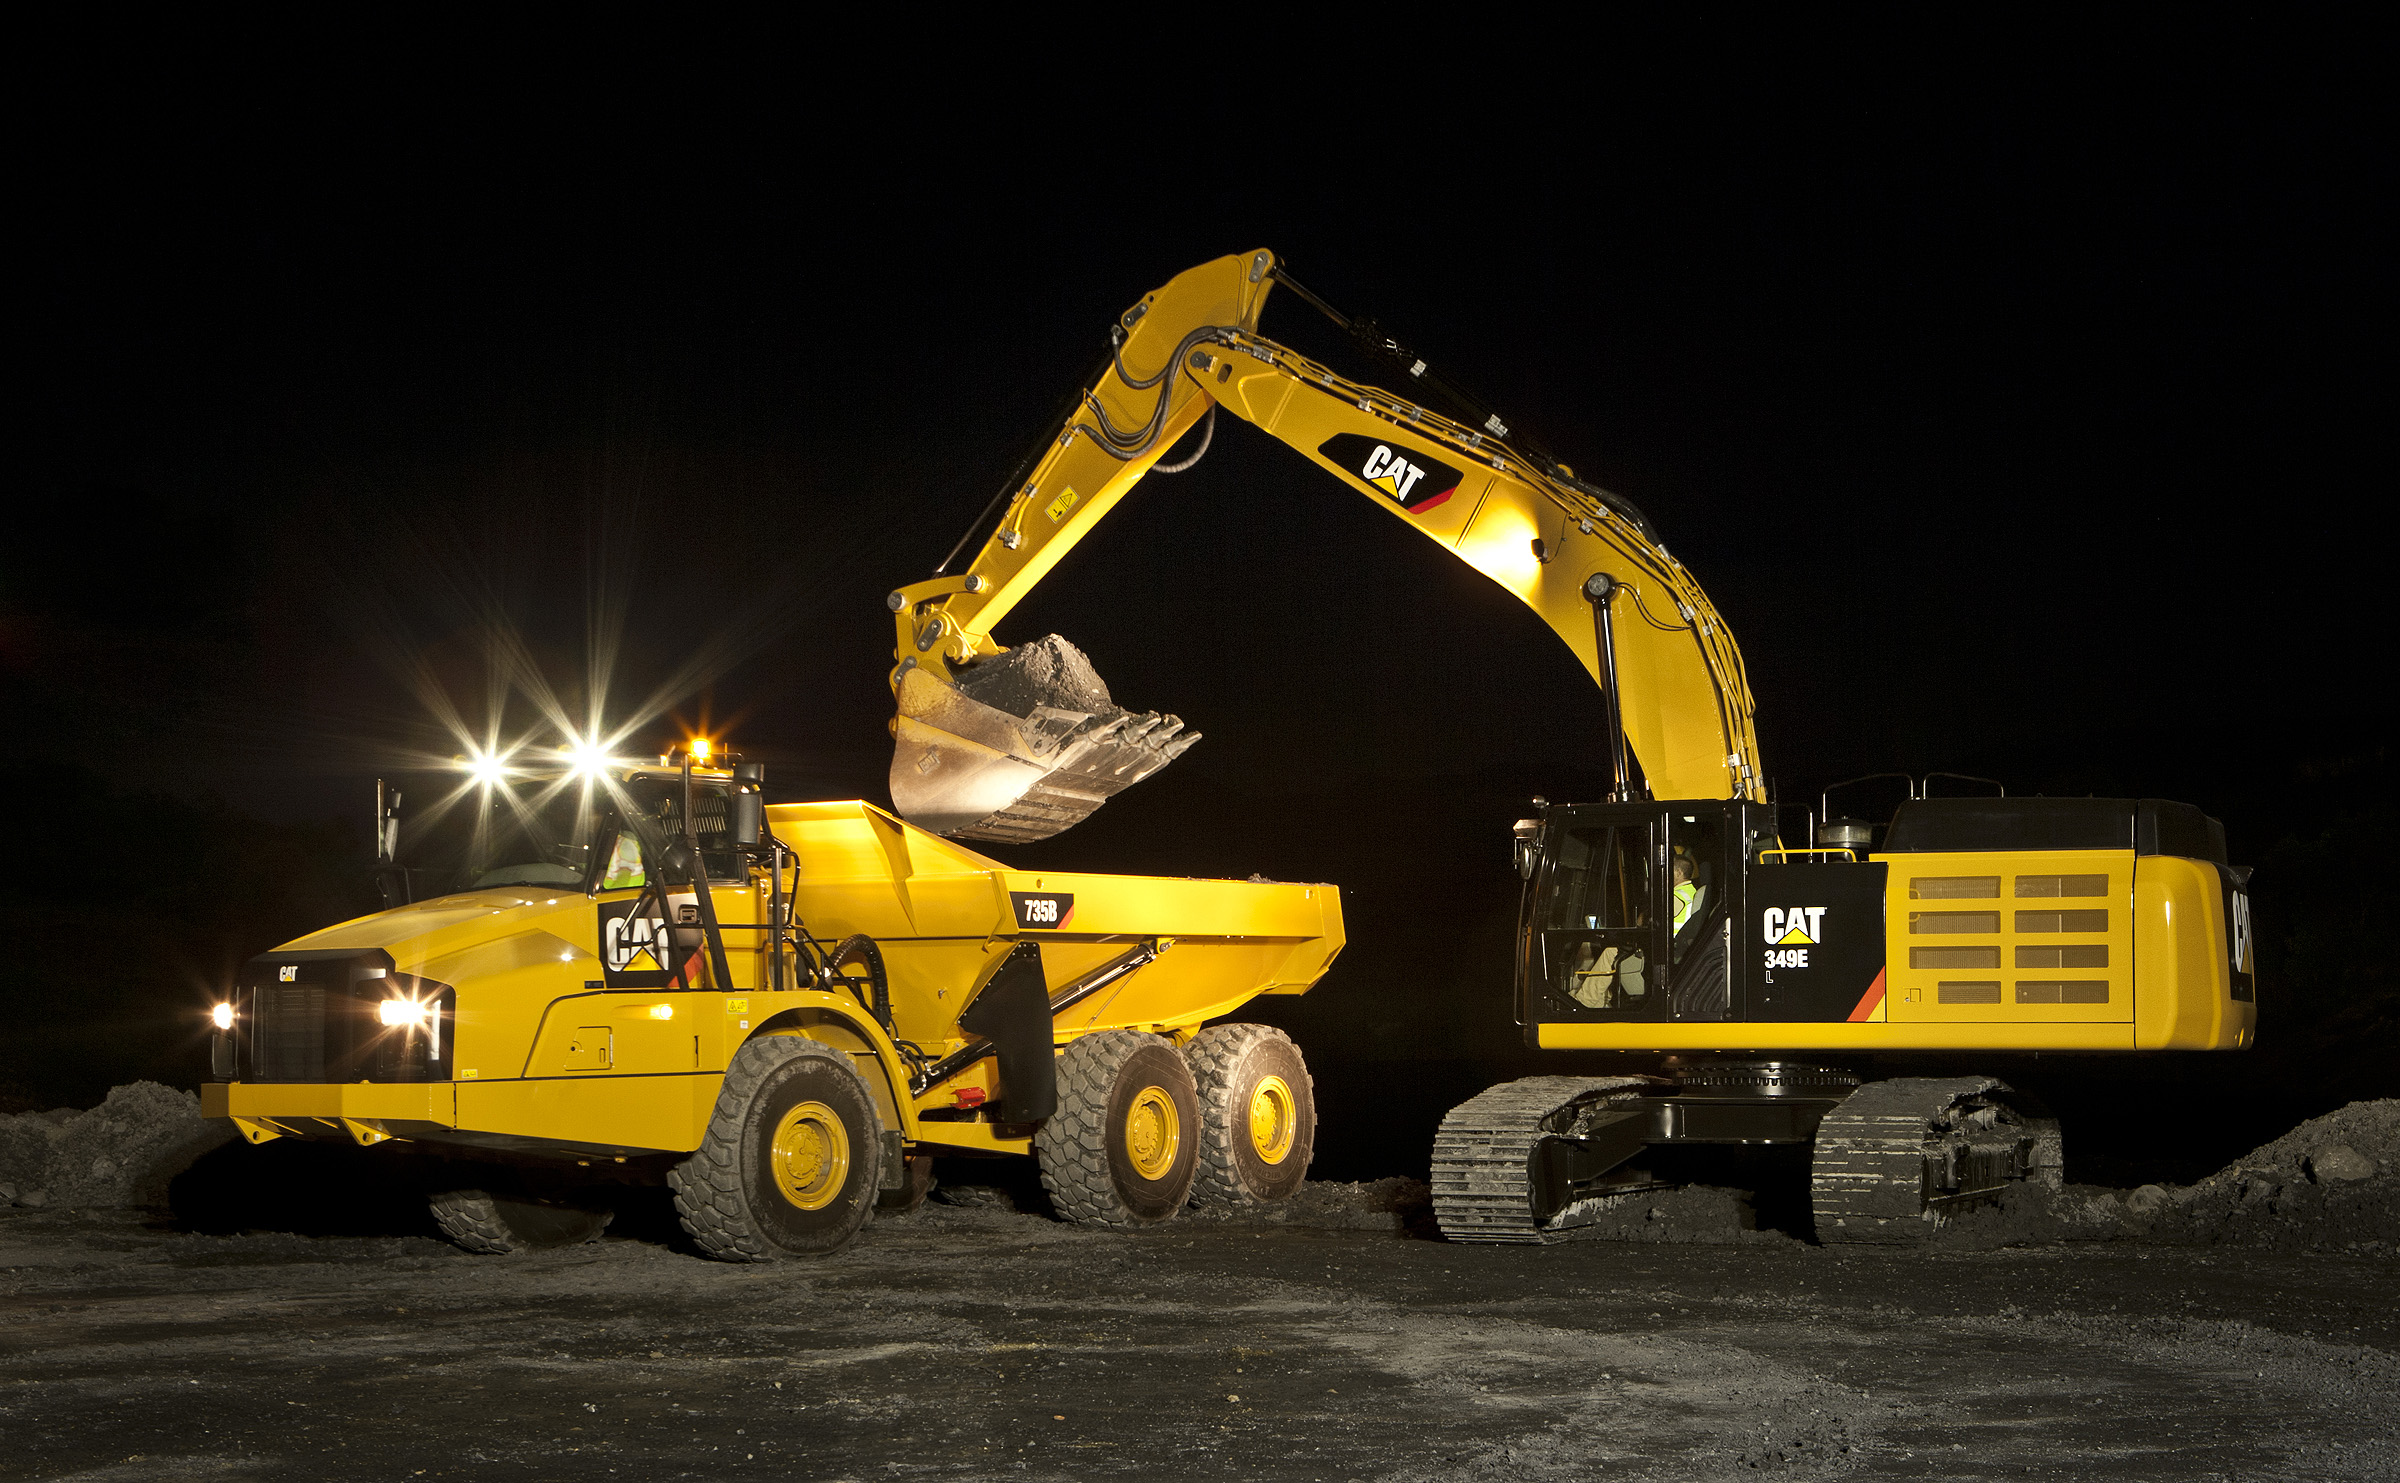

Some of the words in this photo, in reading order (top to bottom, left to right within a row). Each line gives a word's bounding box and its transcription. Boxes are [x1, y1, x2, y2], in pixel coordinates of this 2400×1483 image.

[1362, 445, 1426, 501] CAT
[1024, 899, 1058, 922] 735B
[1763, 907, 1827, 945] CAT
[606, 917, 669, 972] CAT
[1764, 949, 1809, 969] 349E
[279, 965, 298, 982] CAT
[1765, 970, 1774, 984] L
